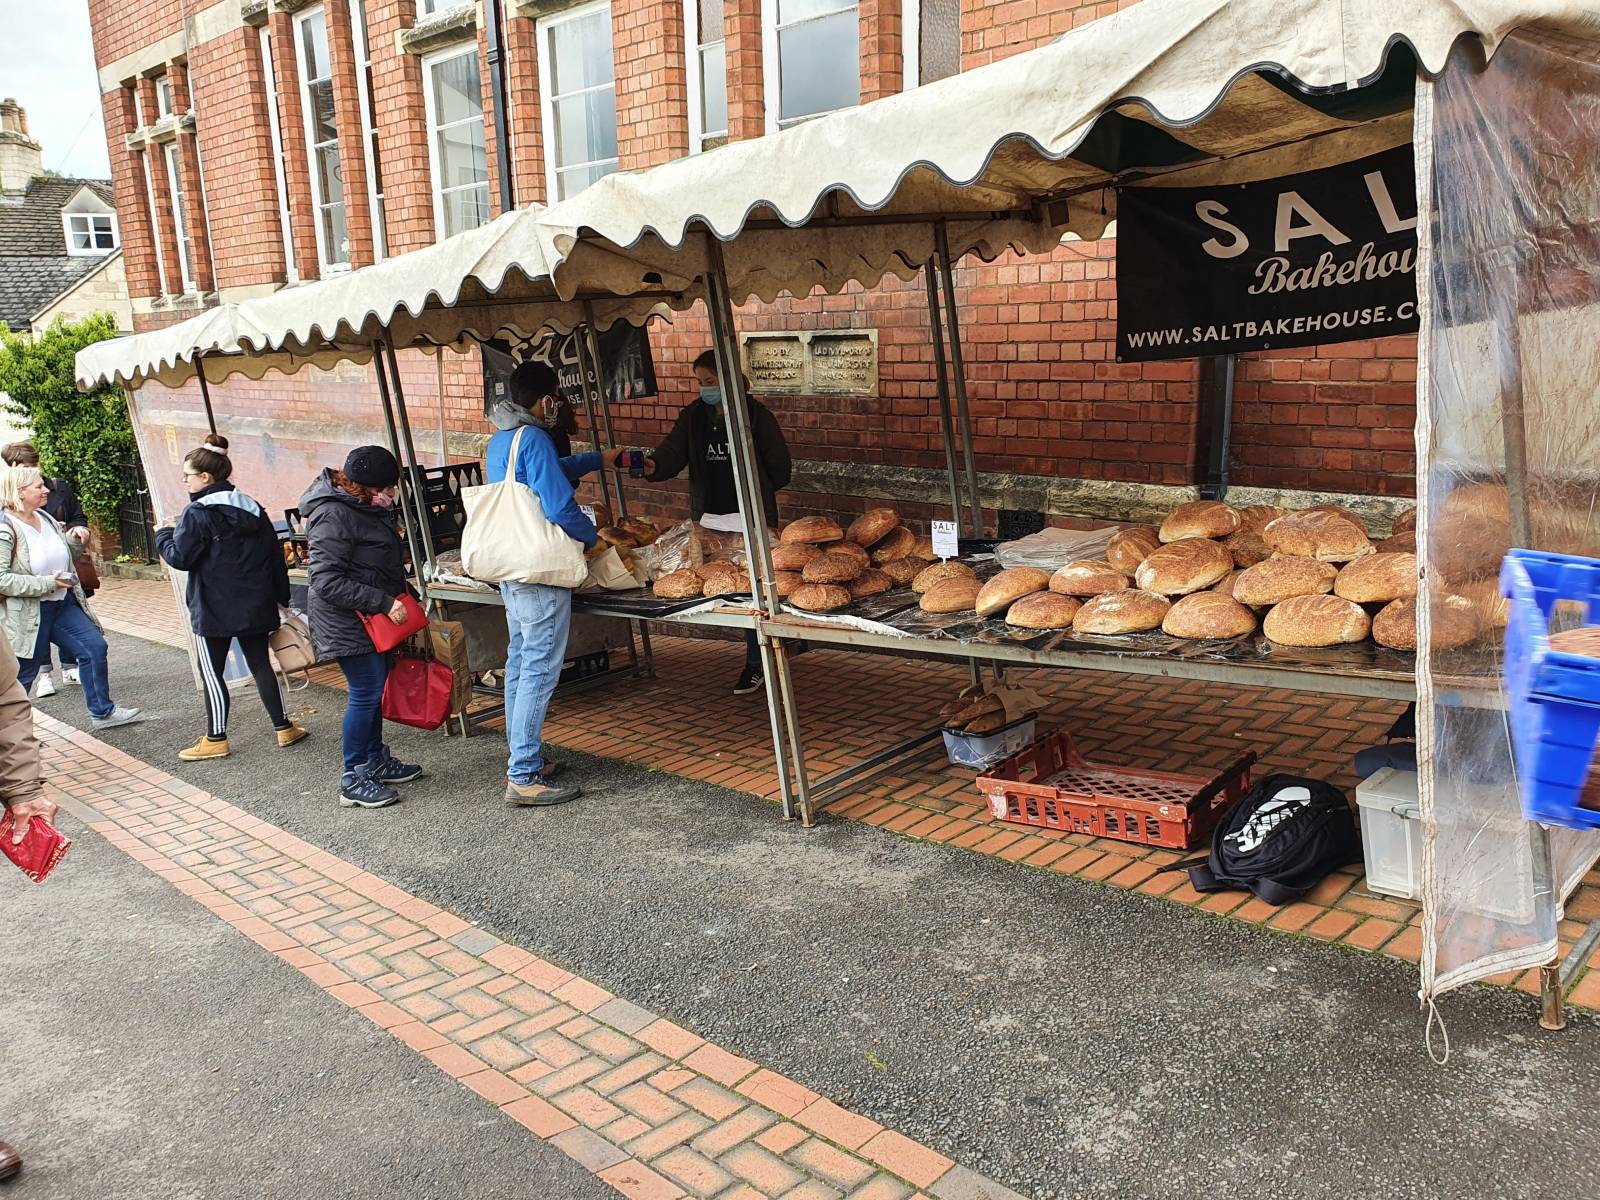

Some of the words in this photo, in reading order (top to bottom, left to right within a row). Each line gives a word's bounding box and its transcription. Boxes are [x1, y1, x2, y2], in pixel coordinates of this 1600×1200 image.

[1195, 170, 1419, 259] SAL
[1247, 241, 1417, 295] Bakehou
[1127, 301, 1421, 348] WWW.SALTBAKEHOUSE.C
[707, 442, 731, 456] ALT
[933, 522, 955, 530] SALT
